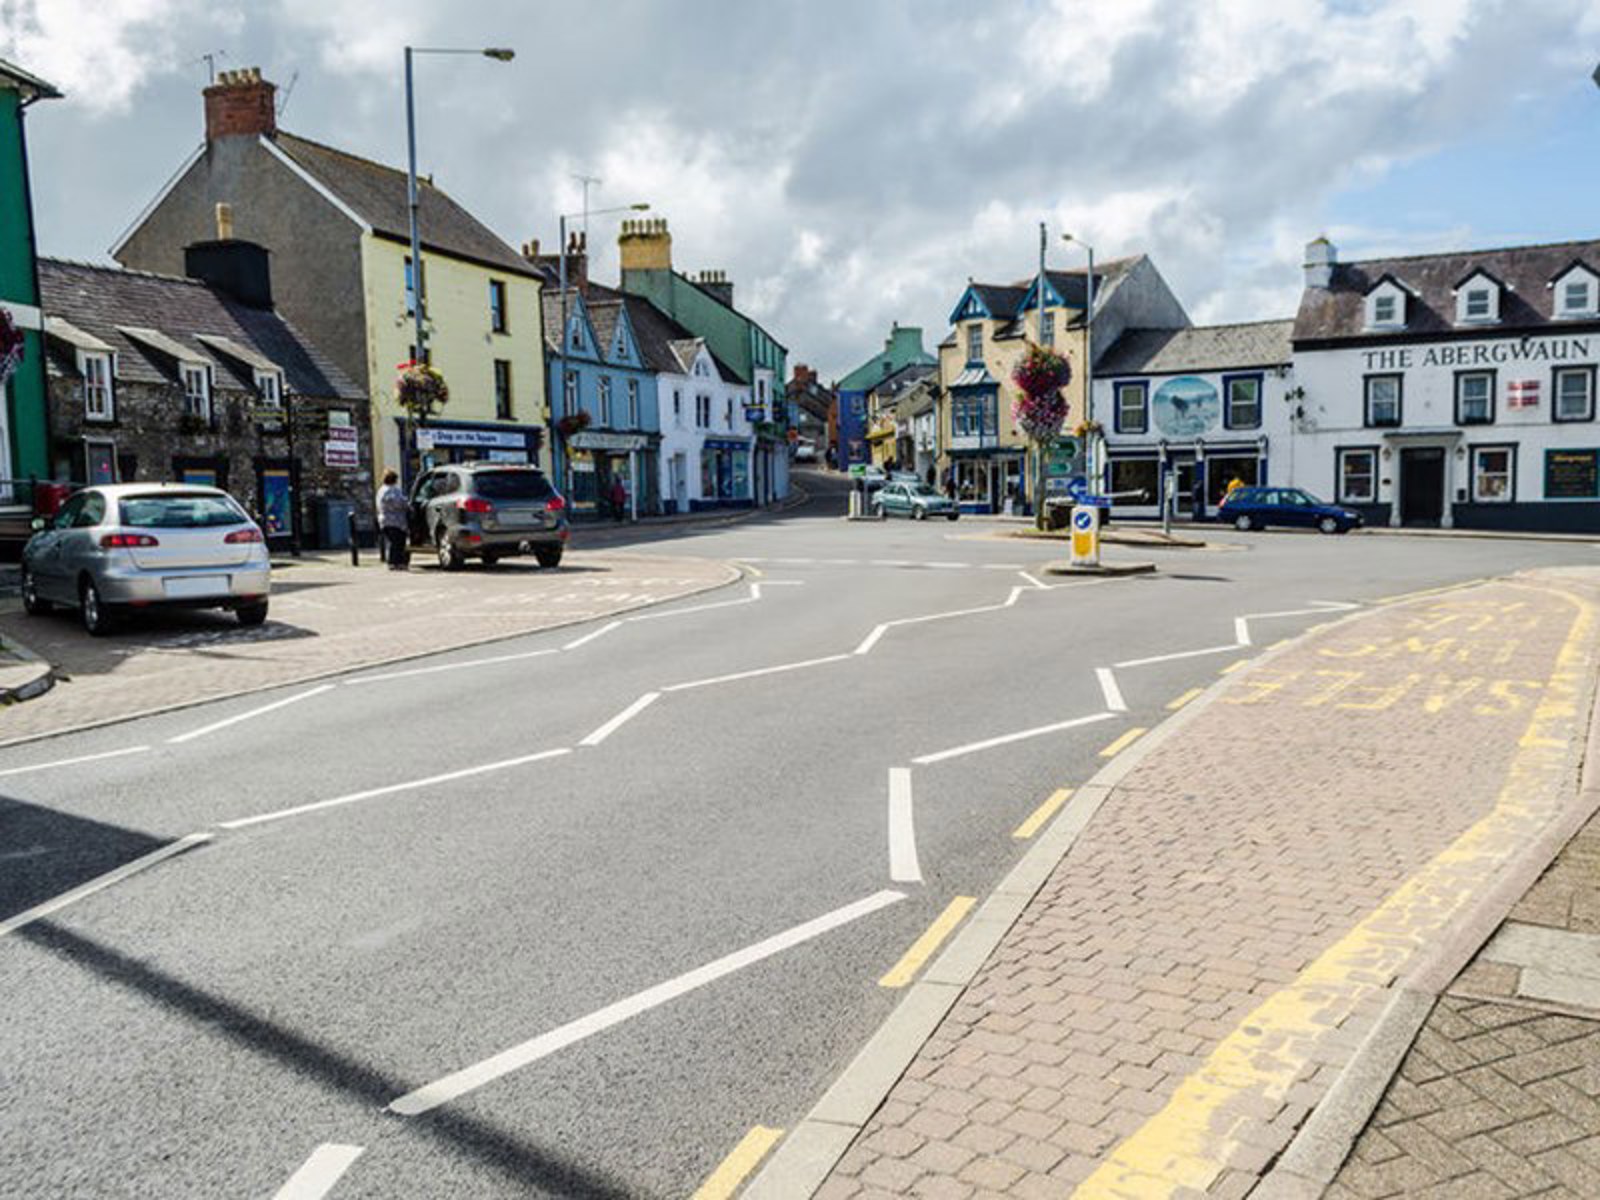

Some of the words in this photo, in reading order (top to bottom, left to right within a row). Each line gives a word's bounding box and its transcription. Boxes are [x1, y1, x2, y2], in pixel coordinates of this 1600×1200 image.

[1362, 349, 1413, 370] THE
[1422, 338, 1590, 367] ABERGWAUN
[437, 432, 452, 443] Shop
[475, 433, 497, 443] Square
